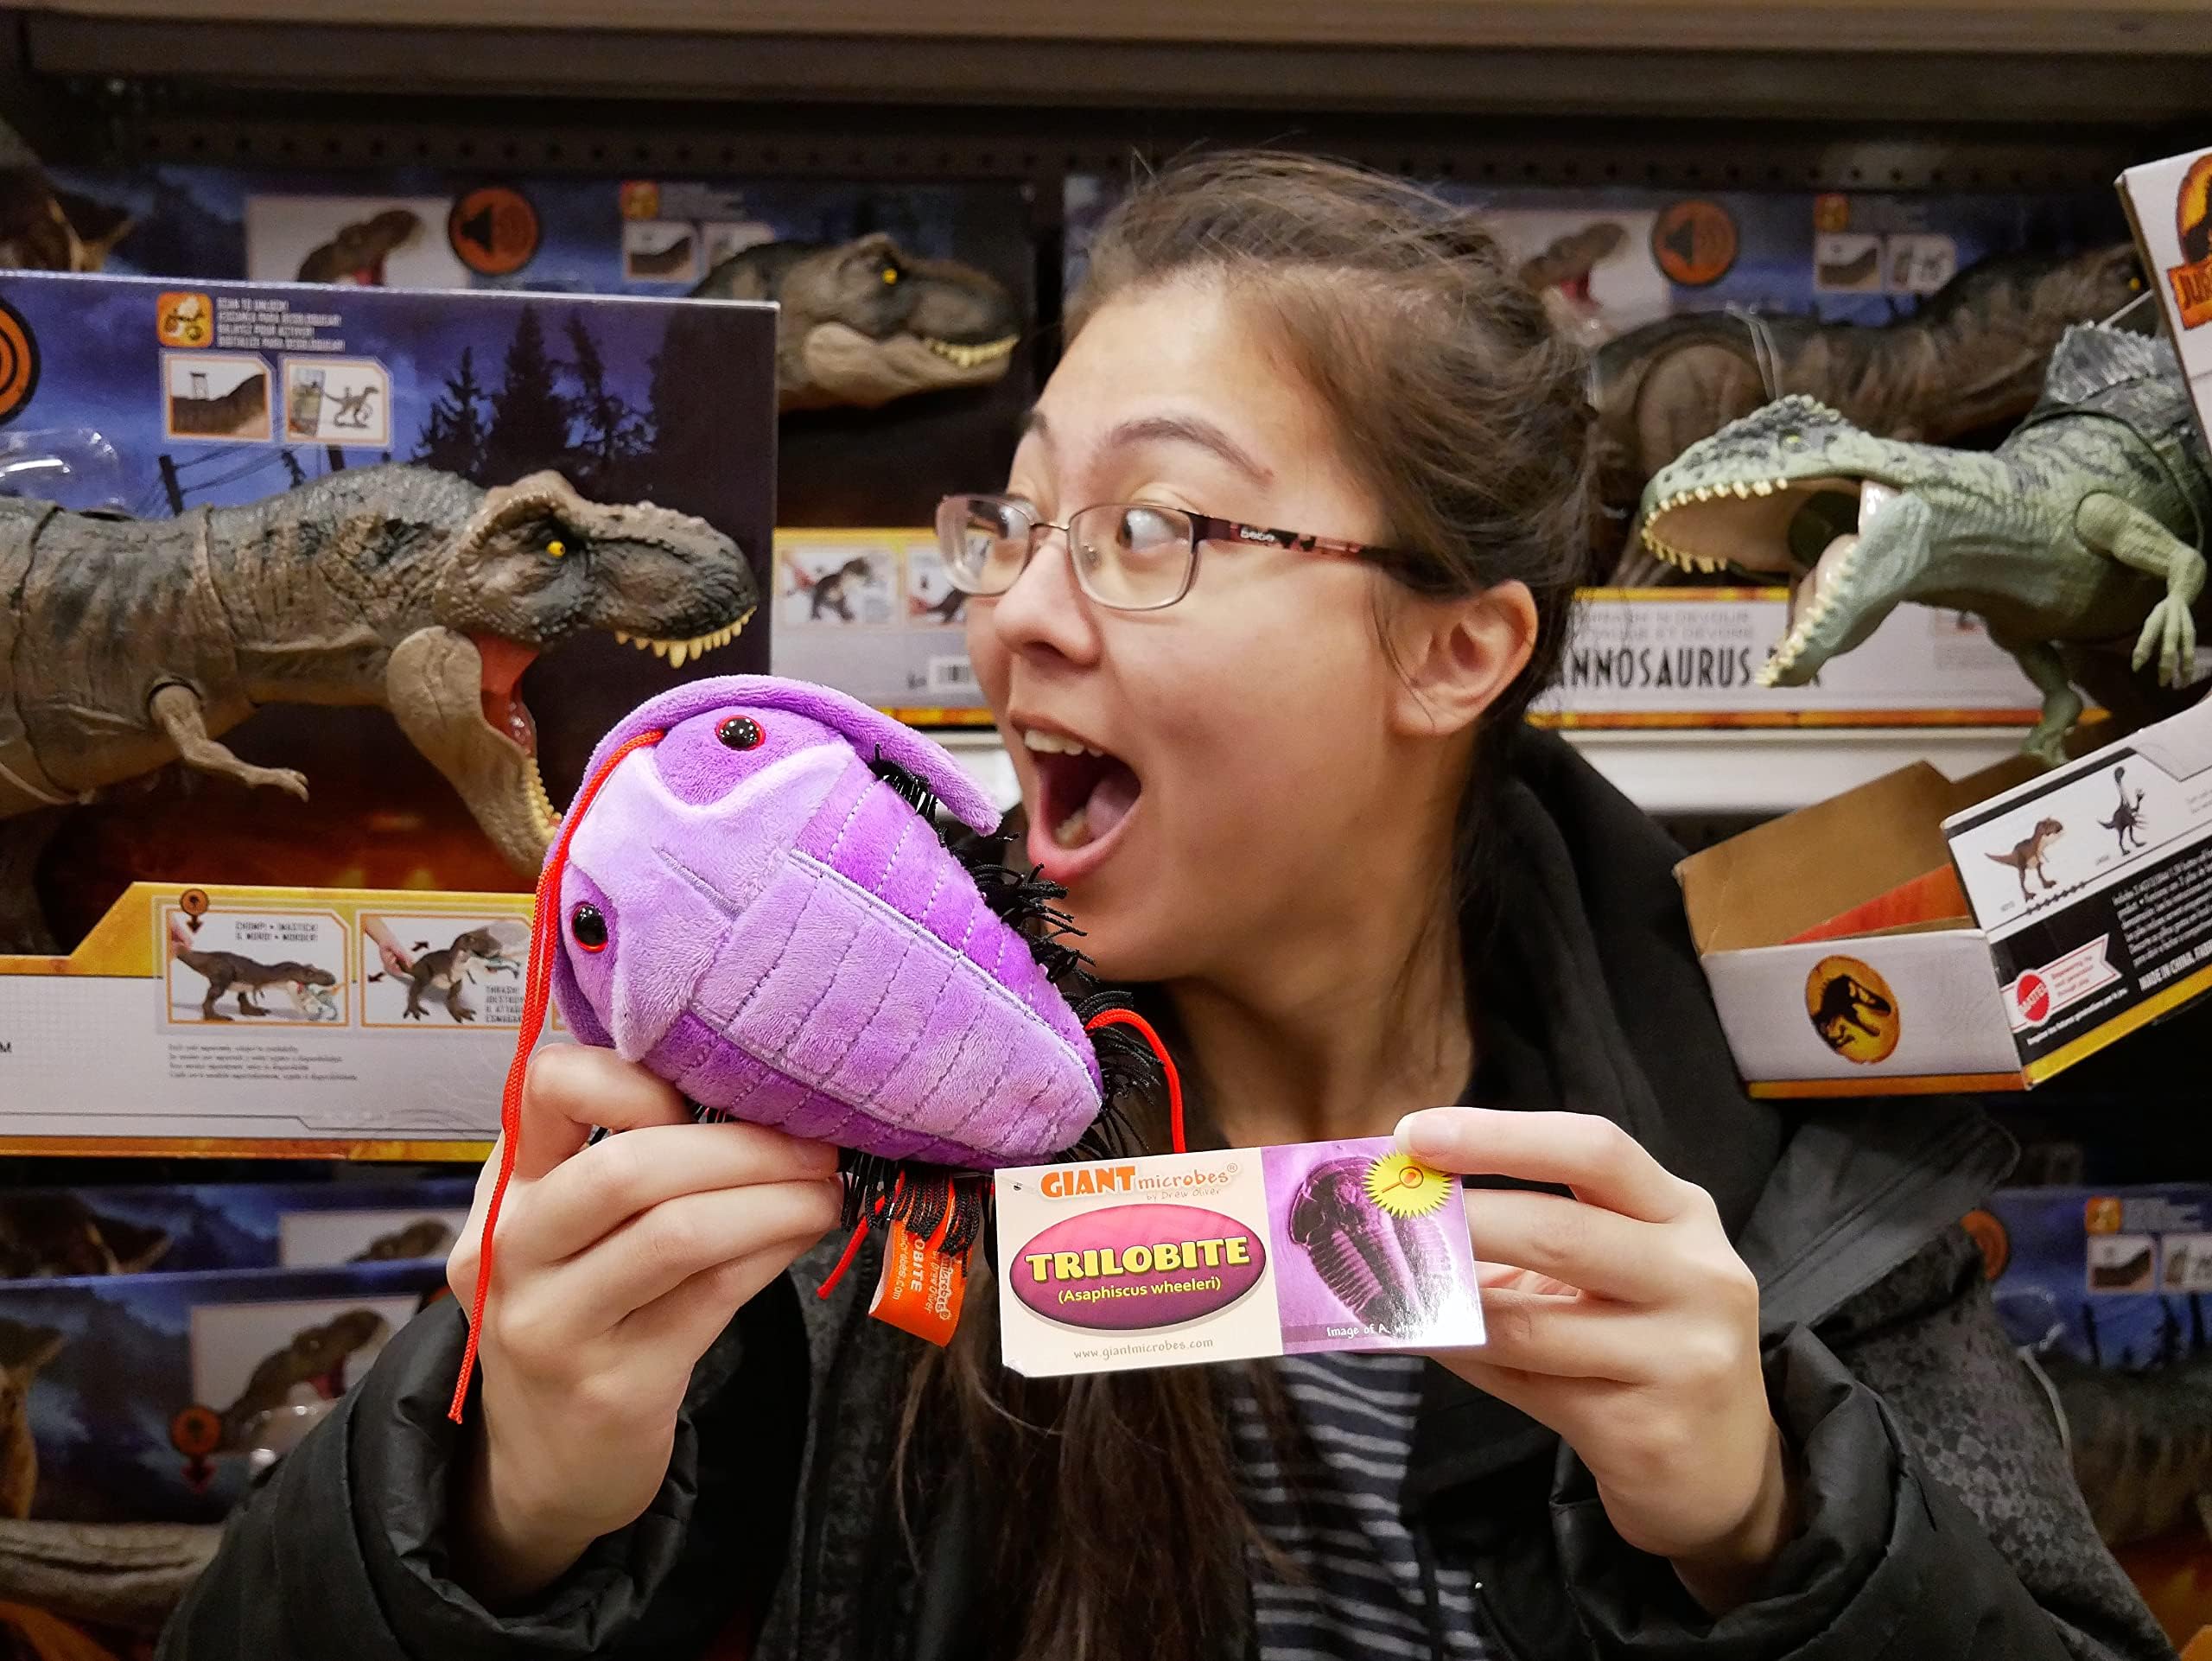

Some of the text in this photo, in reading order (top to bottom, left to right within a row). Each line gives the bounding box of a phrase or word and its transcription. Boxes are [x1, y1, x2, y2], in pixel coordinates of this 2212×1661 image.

[1562, 647, 1751, 687] NNOSAURUS
[1147, 1188, 1222, 1202] by Drew Oliver
[910, 1238, 925, 1292] OBITE
[1025, 1236, 1251, 1282] TRILOBITE
[1058, 1276, 1222, 1305] (Asaphiscus wheeleri)
[1326, 1326, 1360, 1340] Image
[1363, 1323, 1375, 1334] of
[1073, 1338, 1213, 1360] www.giantmicrobes.com
